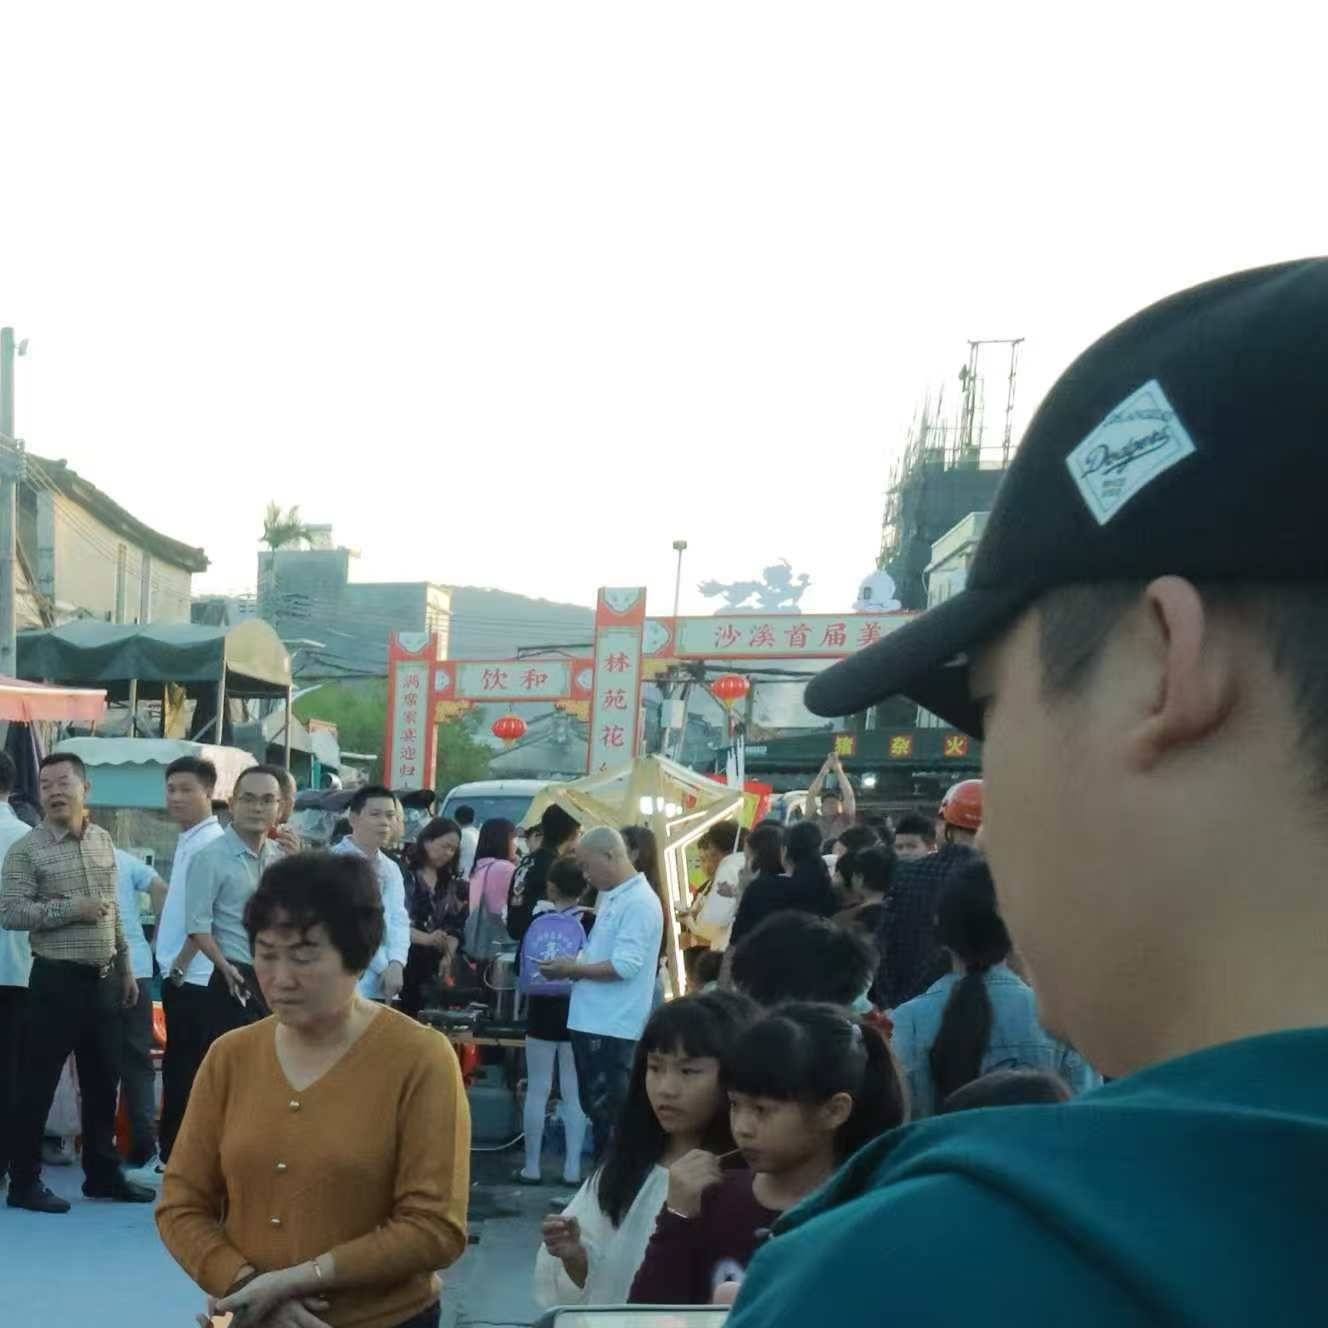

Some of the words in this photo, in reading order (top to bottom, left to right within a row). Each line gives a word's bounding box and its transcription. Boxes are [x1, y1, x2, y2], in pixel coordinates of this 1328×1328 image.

[481, 668, 548, 691] 饮和
[601, 652, 630, 773] 林苑花
